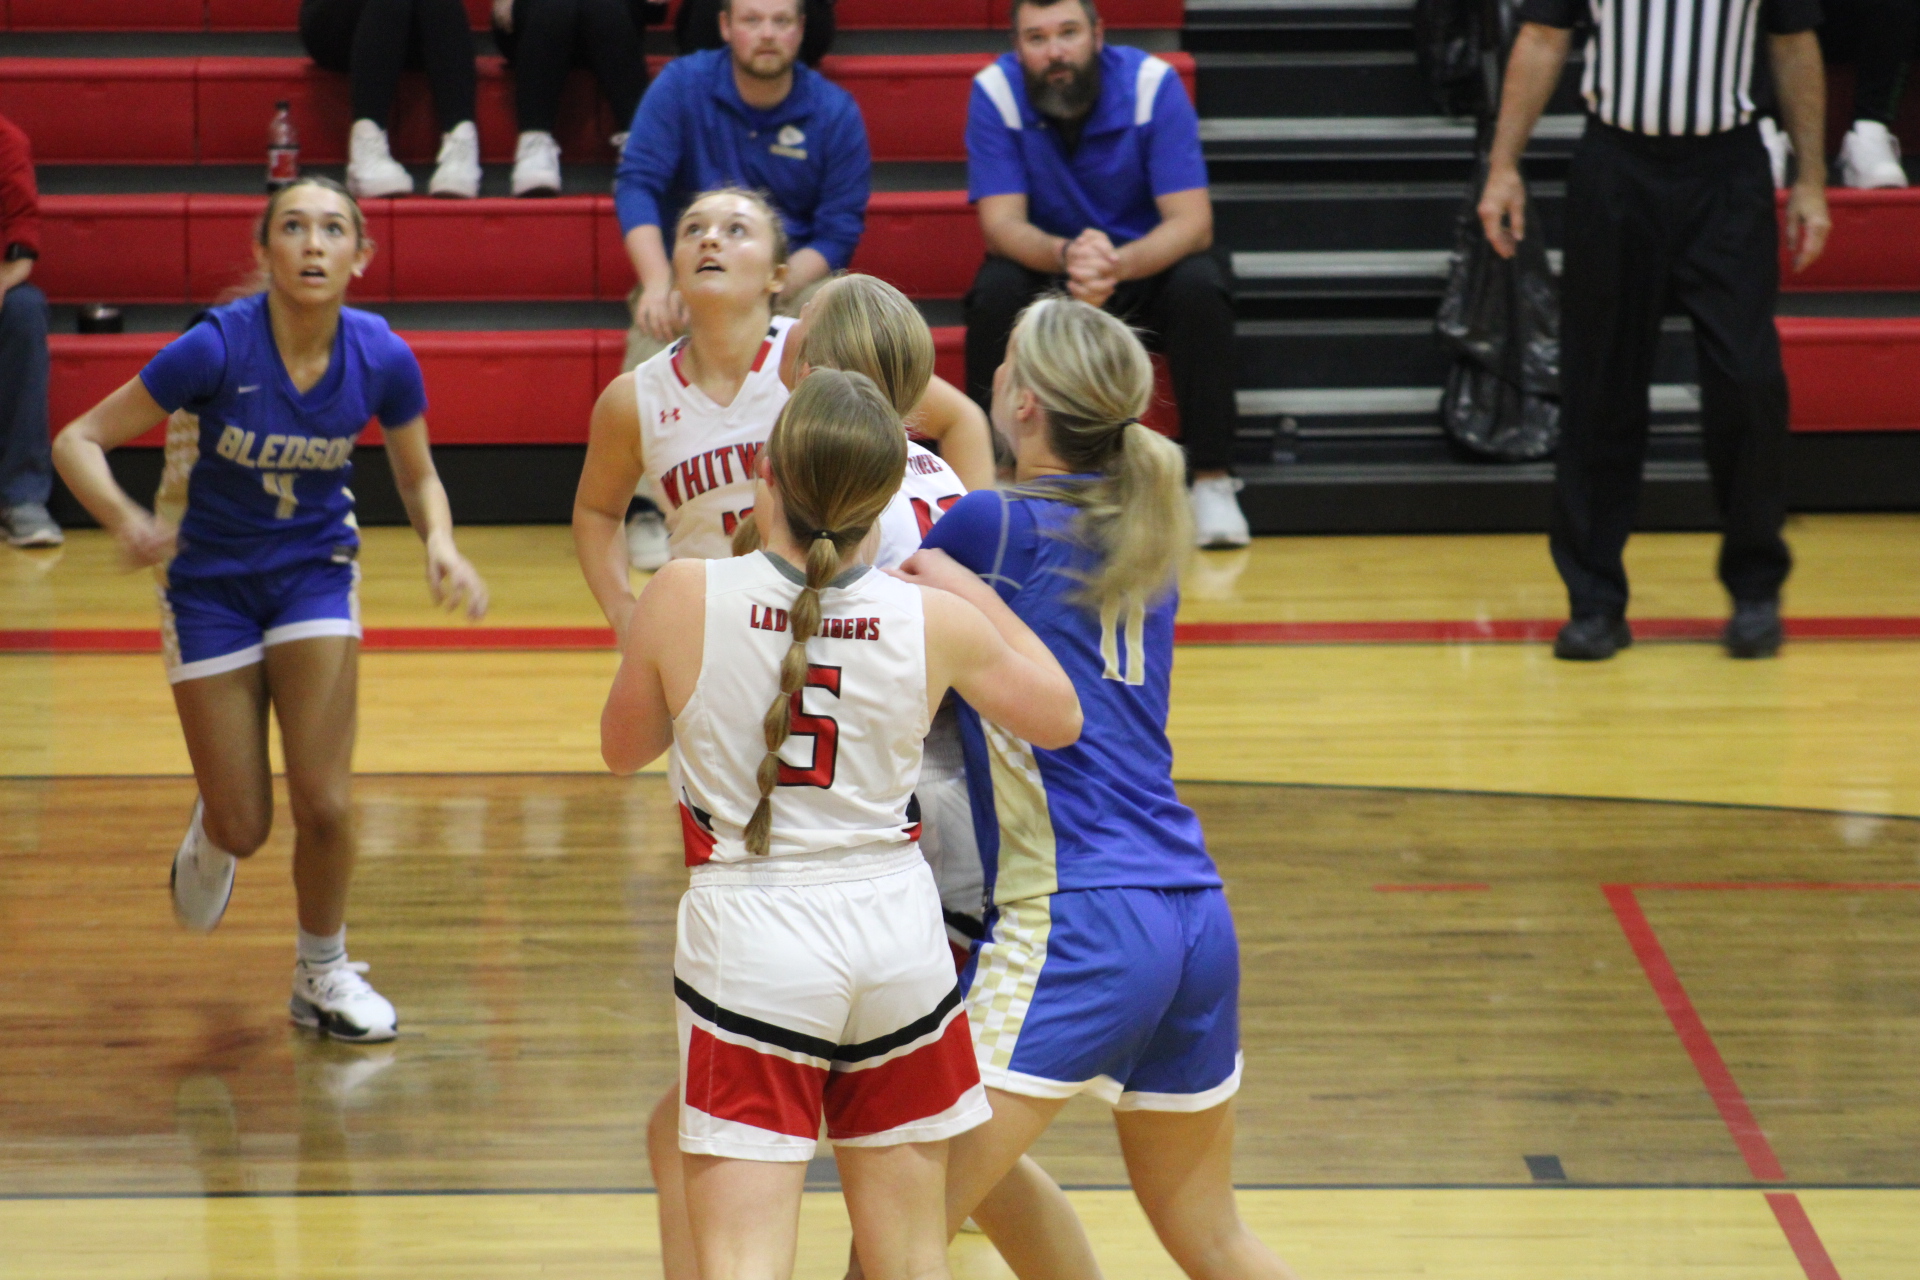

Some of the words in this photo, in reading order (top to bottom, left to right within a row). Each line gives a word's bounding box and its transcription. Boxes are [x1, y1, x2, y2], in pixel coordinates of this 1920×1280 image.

[262, 472, 299, 519] 4
[750, 604, 793, 634] LAD
[812, 617, 881, 641] IGERS
[776, 663, 842, 789] 5
